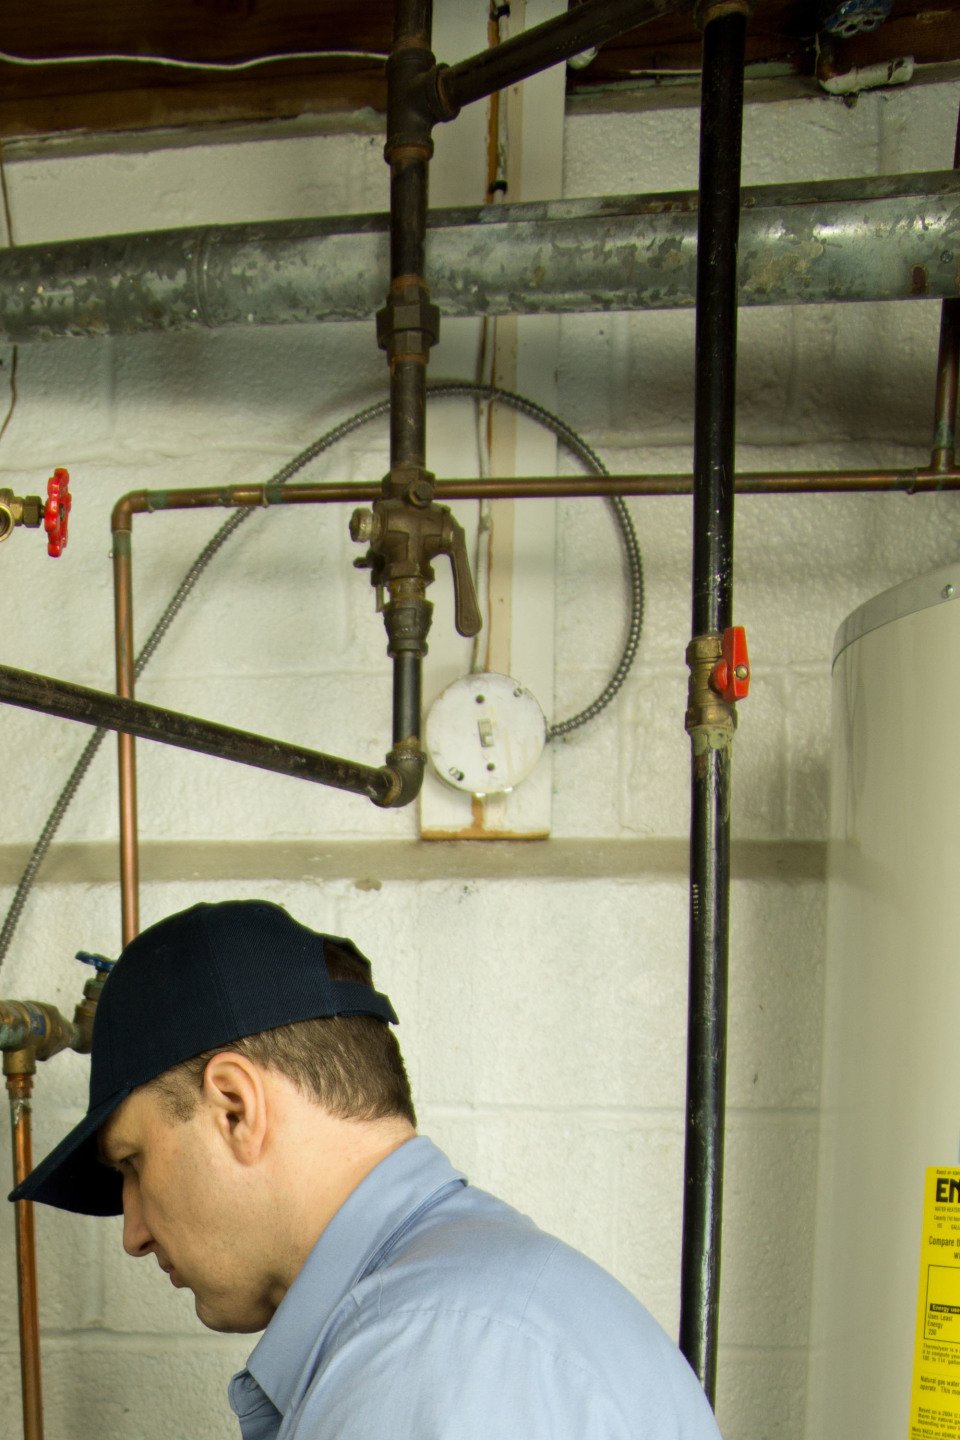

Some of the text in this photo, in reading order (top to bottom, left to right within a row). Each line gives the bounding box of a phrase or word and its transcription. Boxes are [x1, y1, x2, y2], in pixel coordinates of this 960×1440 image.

[936, 1178, 960, 1203] EN
[929, 1236, 954, 1247] Compare
[932, 1304, 949, 1312] Energy
[927, 1320, 943, 1329] Energy
[920, 1375, 936, 1384] Natural
